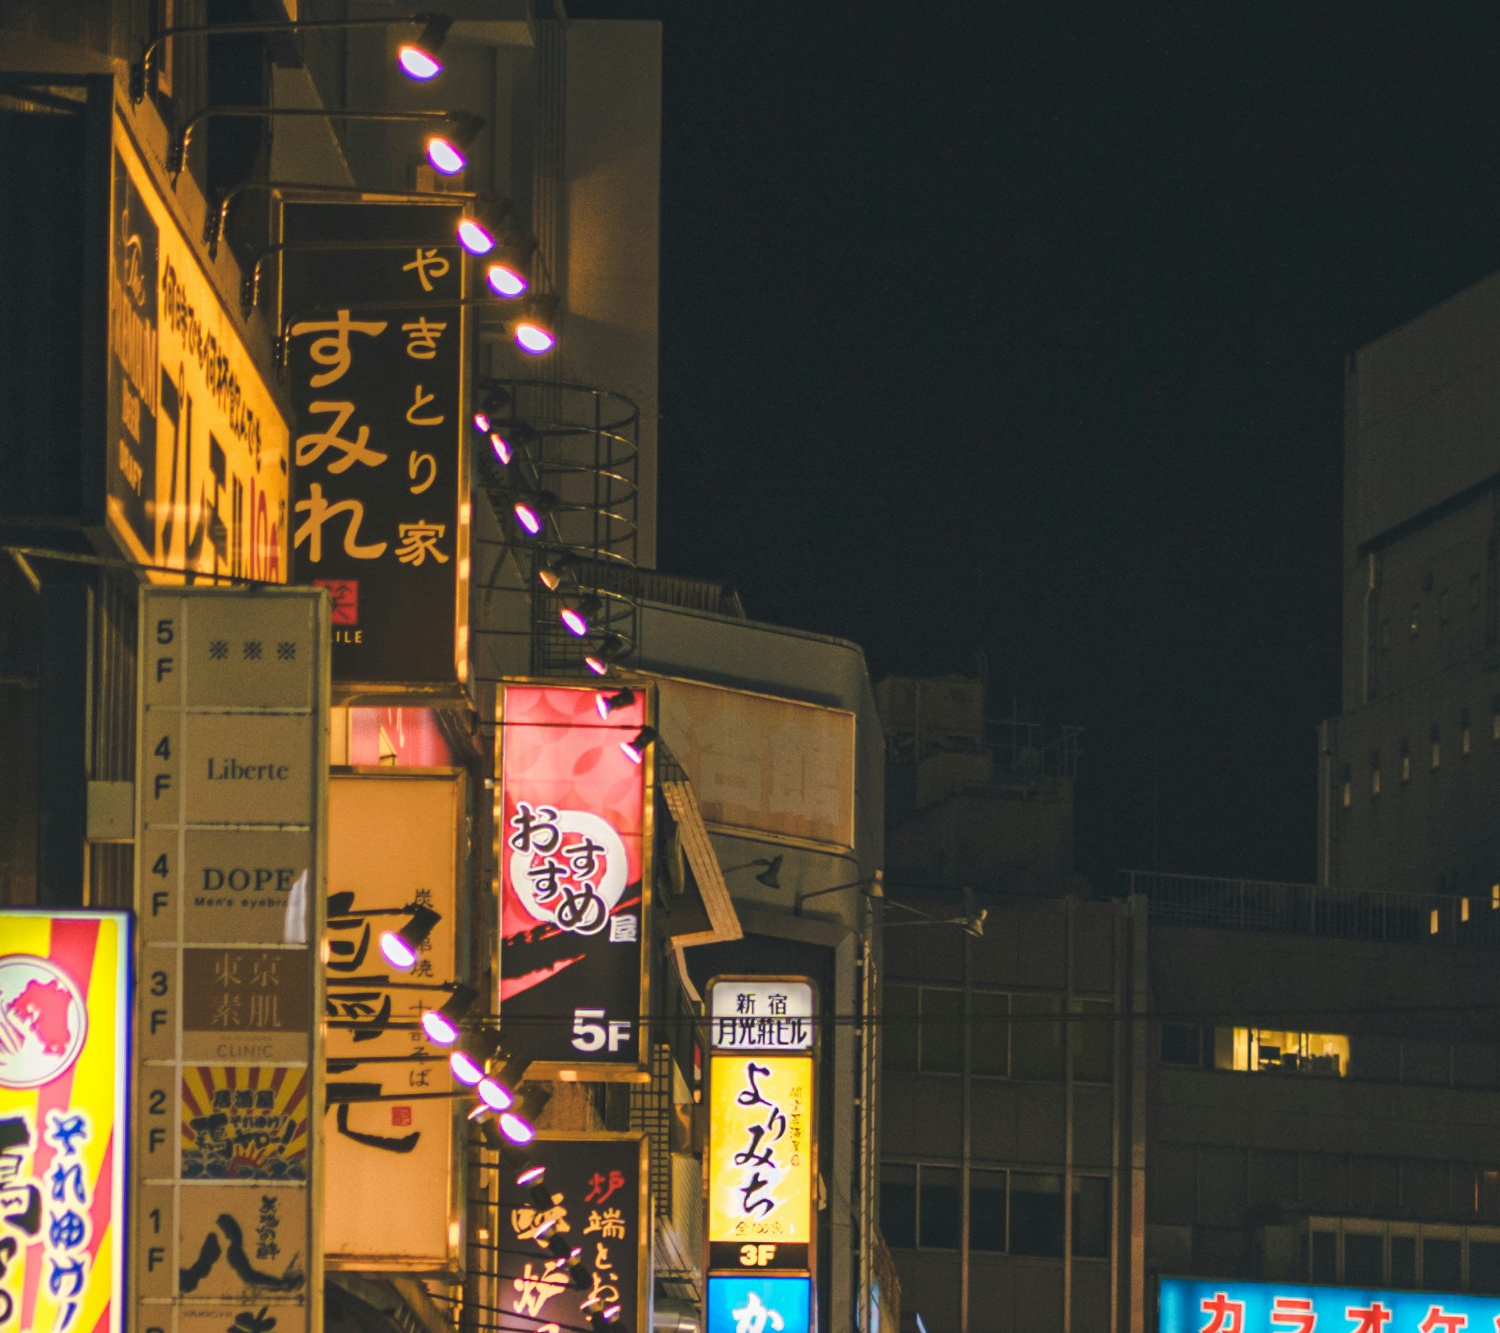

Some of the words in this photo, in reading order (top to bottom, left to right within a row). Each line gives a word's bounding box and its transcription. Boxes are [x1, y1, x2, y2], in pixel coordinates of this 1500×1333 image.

[396, 248, 450, 567] やきとり家
[291, 308, 388, 564] すみれ
[207, 757, 290, 781] Liberte
[202, 867, 295, 893] DOPE
[212, 954, 283, 989] 東京
[211, 995, 283, 1030] 素肌
[735, 992, 788, 1016] 新宿
[570, 1008, 632, 1053] 5F
[216, 1043, 274, 1059] CLINIC
[213, 1089, 275, 1111] 居酒屋
[734, 1062, 787, 1218] よりみち
[739, 1244, 776, 1267] 3F
